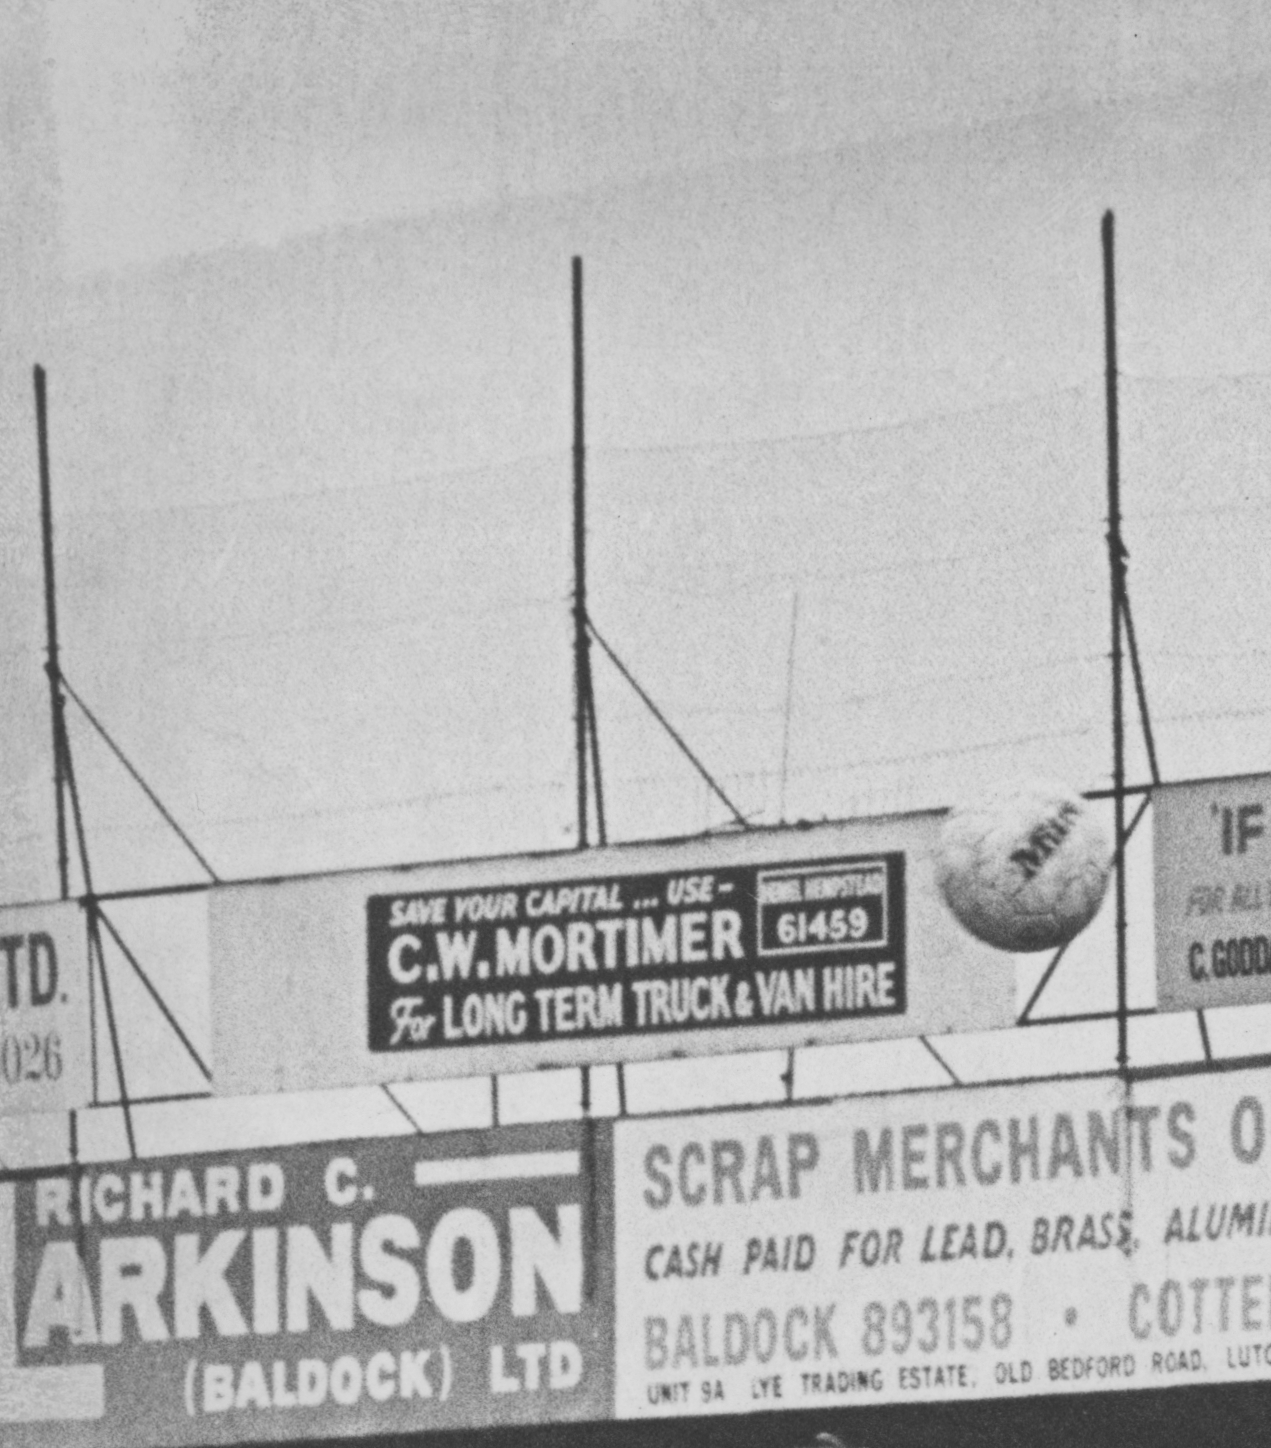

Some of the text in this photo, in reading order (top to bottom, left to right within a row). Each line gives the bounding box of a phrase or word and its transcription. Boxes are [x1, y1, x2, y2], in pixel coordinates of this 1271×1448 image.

[389, 896, 450, 928] SAVE
[453, 892, 519, 924] YOUR
[525, 883, 623, 918] CAPITAL
[666, 874, 715, 906] USE
[776, 906, 869, 945] 61459
[389, 961, 897, 1046] For LONG TERM TRUCK & VAN HIRE
[643, 1131, 821, 1210] SCRAP
[853, 1101, 1197, 1195] MERCHANTS
[35, 1157, 375, 1227] RICHARD C.
[645, 1241, 724, 1281] CASH
[743, 1233, 817, 1276] PAID
[838, 1227, 904, 1269] FOR
[643, 1302, 839, 1371] BALDOCK
[860, 1292, 1014, 1356] 893158
[184, 1340, 584, 1417] (BALDOCK) LTD
[647, 1381, 691, 1405] UNIT
[751, 1374, 783, 1400] LYE
[800, 1367, 884, 1397] TRADING
[994, 1360, 1033, 1385] OLD
[1047, 1353, 1137, 1382] BEDFORD
